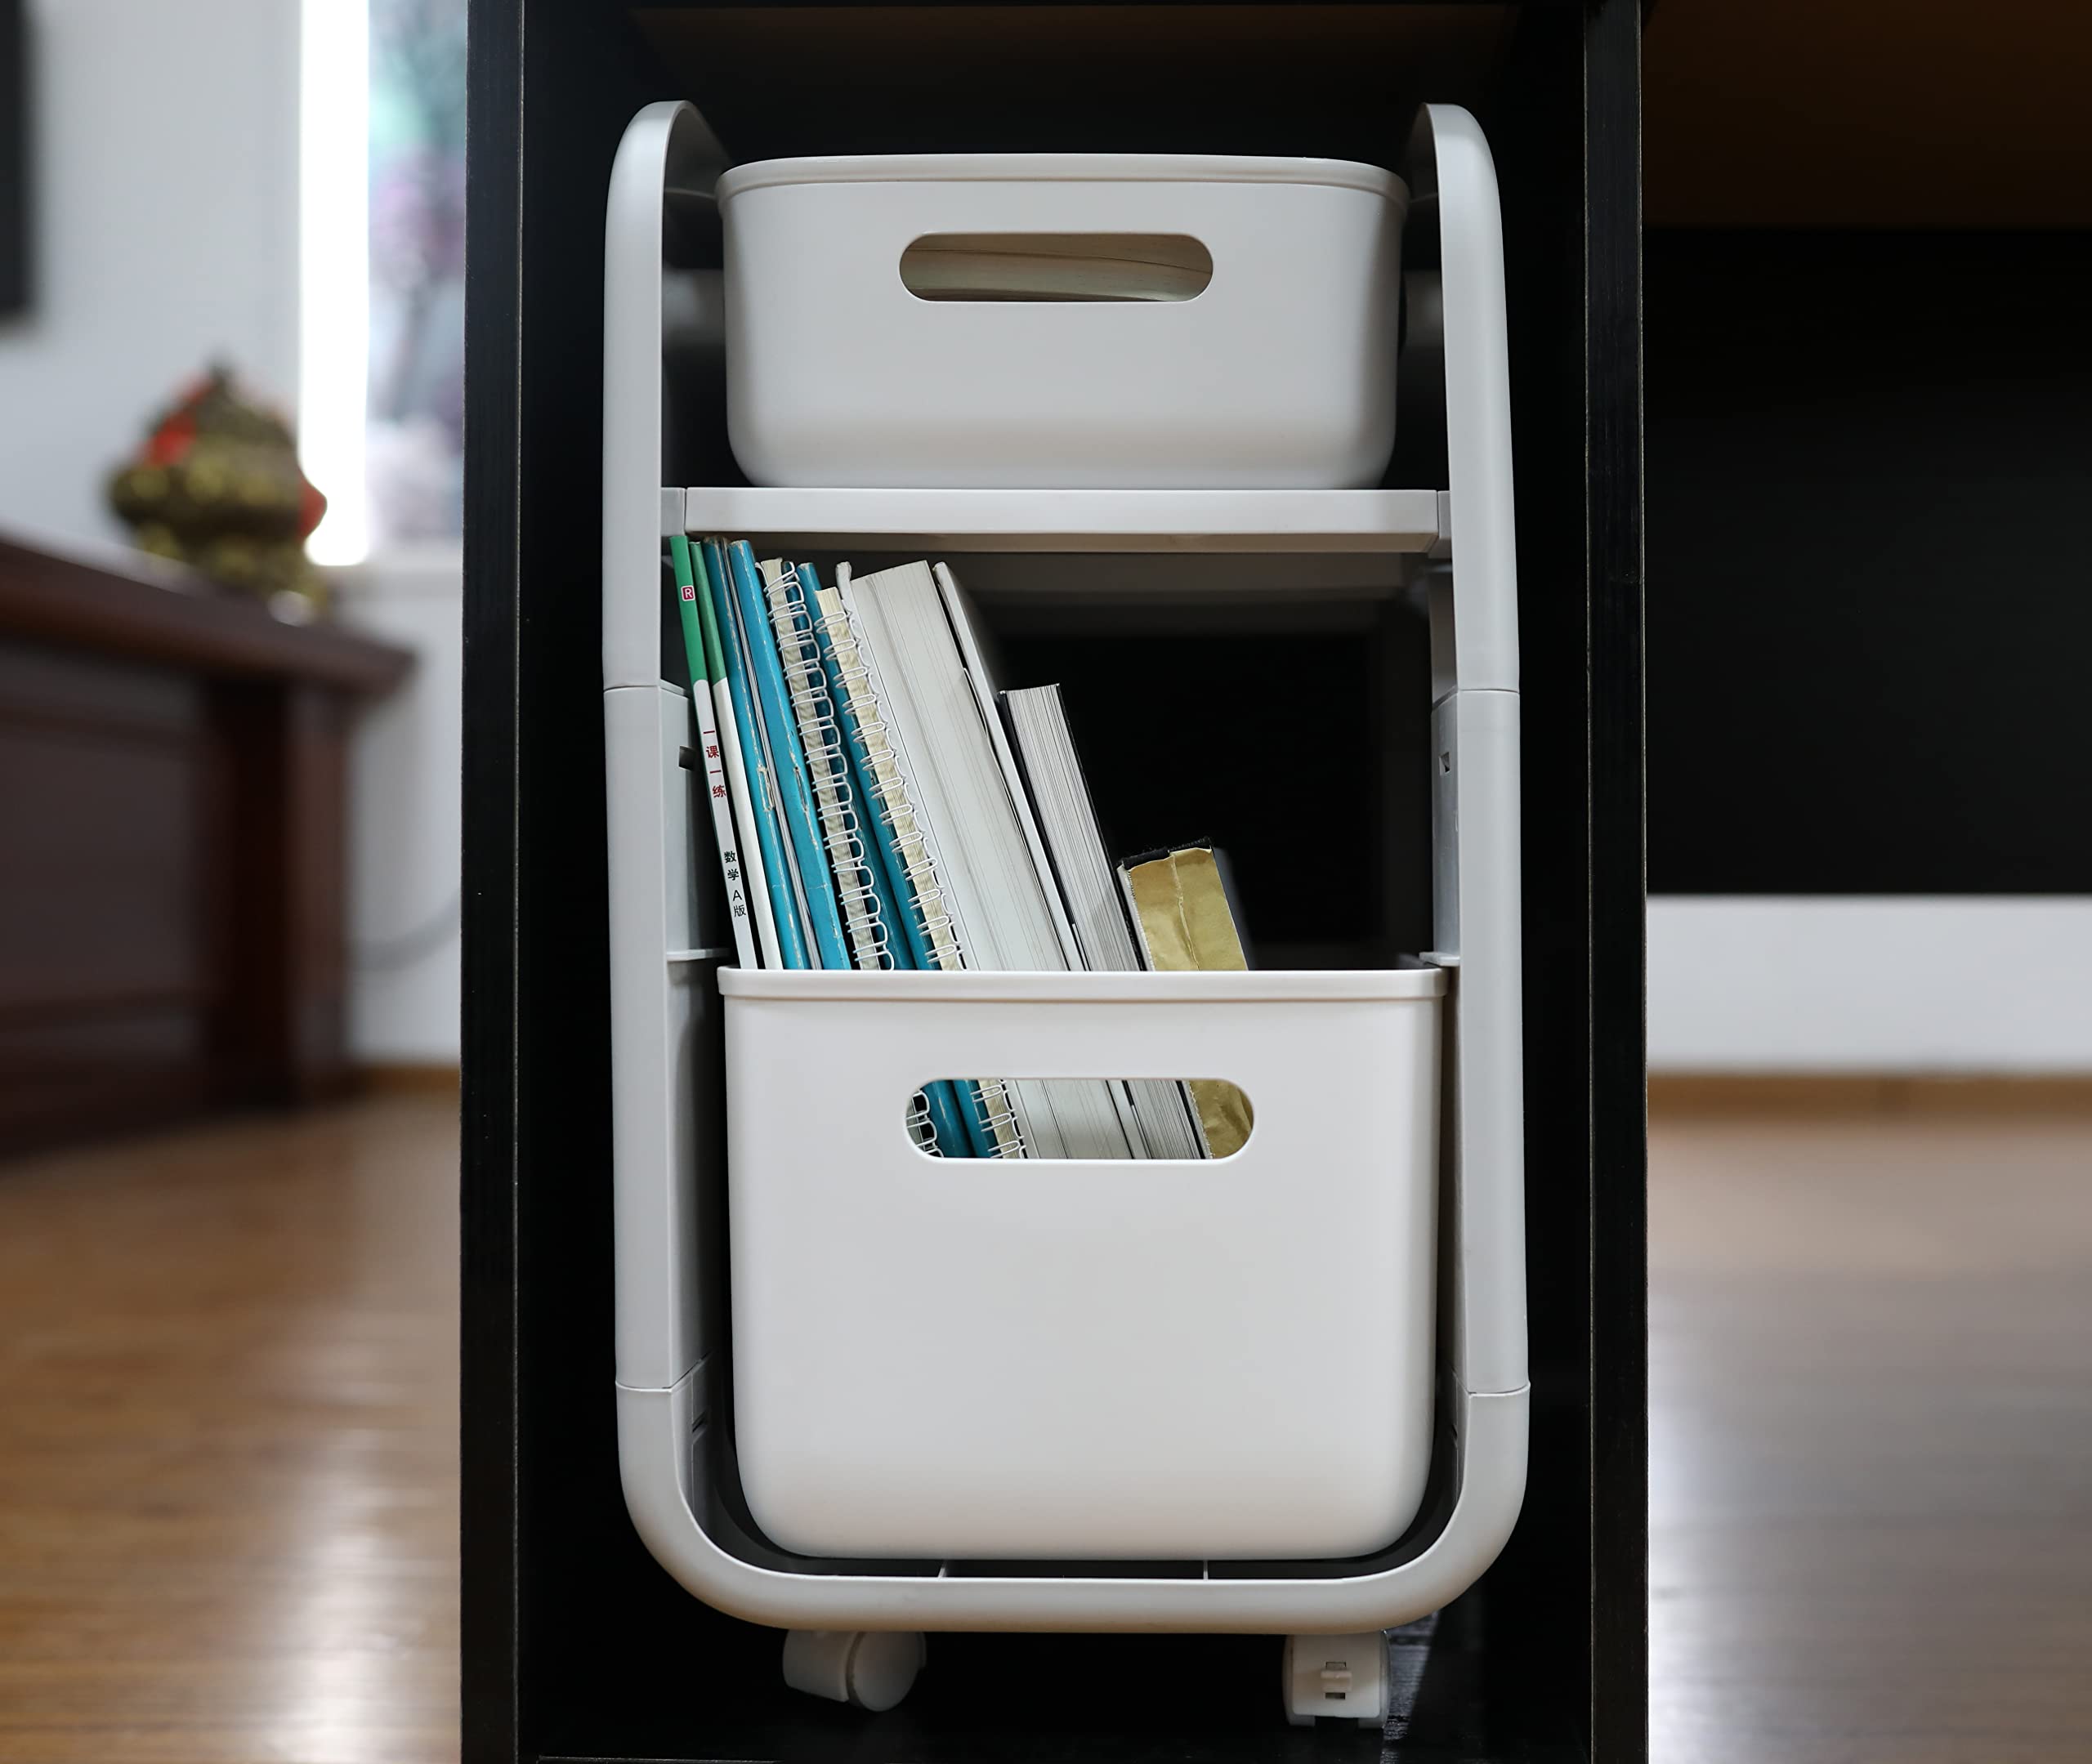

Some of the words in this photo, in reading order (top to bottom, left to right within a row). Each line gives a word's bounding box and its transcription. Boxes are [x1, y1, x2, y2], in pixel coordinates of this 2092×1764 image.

[684, 587, 693, 599] R
[703, 730, 726, 798] 一课一练
[723, 850, 747, 918] 数学A版
